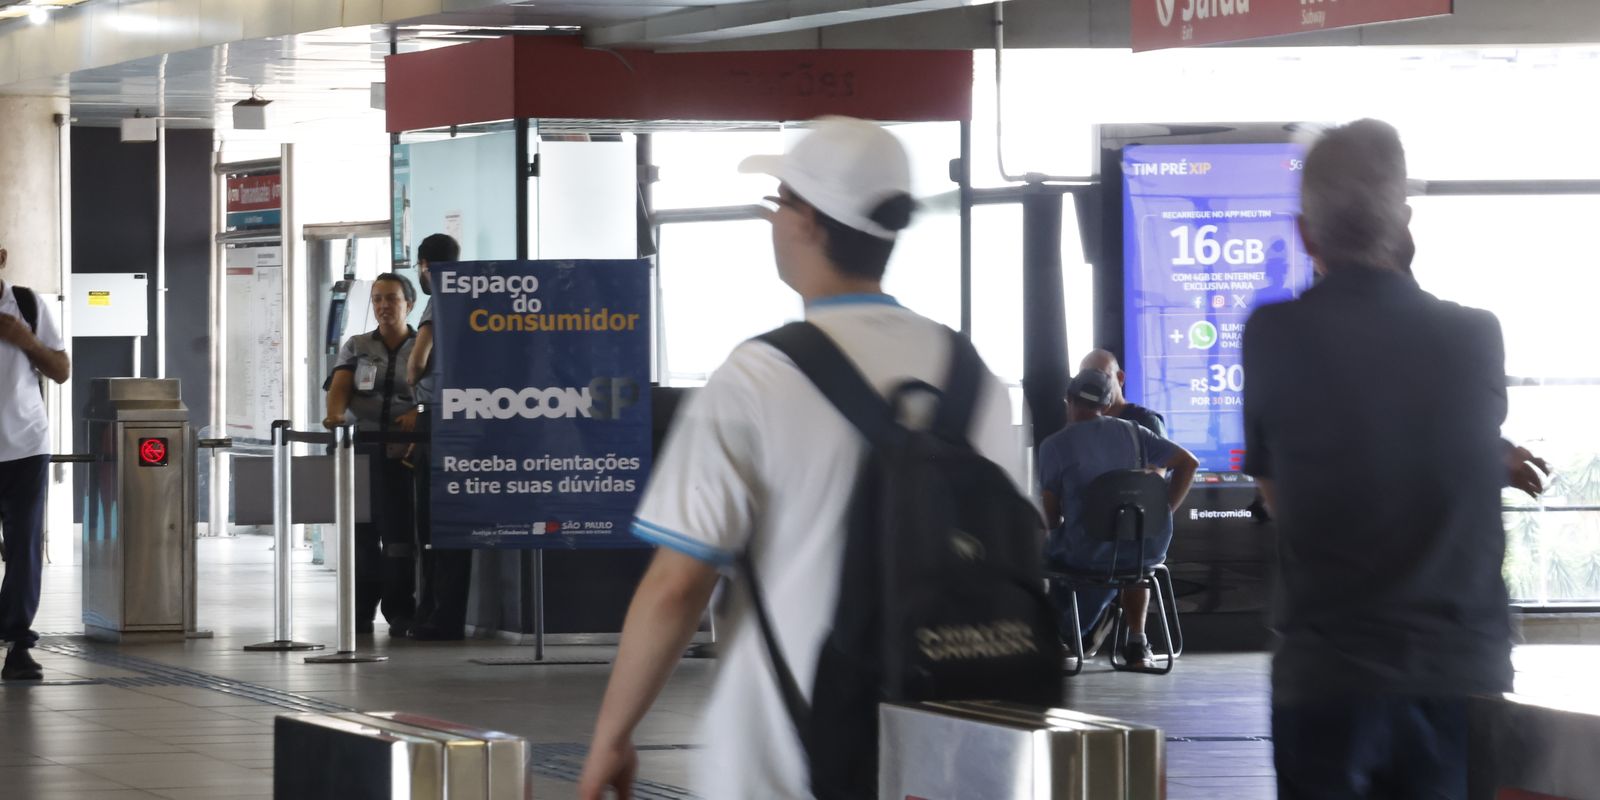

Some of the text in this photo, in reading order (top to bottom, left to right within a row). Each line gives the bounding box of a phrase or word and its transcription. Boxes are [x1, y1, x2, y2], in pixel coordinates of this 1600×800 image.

[1301, 9, 1326, 28] Subway
[1132, 158, 1212, 175] TIM PRÉ XIP
[1288, 159, 1303, 171] 5G
[1162, 211, 1211, 219] RECARREGUE
[1225, 210, 1238, 218] APP
[1258, 209, 1272, 217] TIM
[1169, 224, 1265, 265] 16 GB
[1172, 273, 1192, 281] COM
[1211, 272, 1223, 281] DE
[1224, 271, 1266, 280] INTERNET
[441, 271, 539, 298] Espaço
[1184, 281, 1254, 290] EXCLUSIVA PARA
[513, 294, 542, 313] do
[469, 308, 640, 332] Consumidor
[1221, 332, 1243, 340] PARA
[1229, 340, 1243, 349] MÊ
[1191, 363, 1245, 393] R$ 30
[1191, 396, 1243, 406] POR 30 DIA
[444, 453, 640, 474] Receba orientações
[447, 475, 636, 494] e tire suas dúvidas
[1199, 509, 1252, 518] eletromidia
[561, 520, 613, 530] SÃO PAULO
